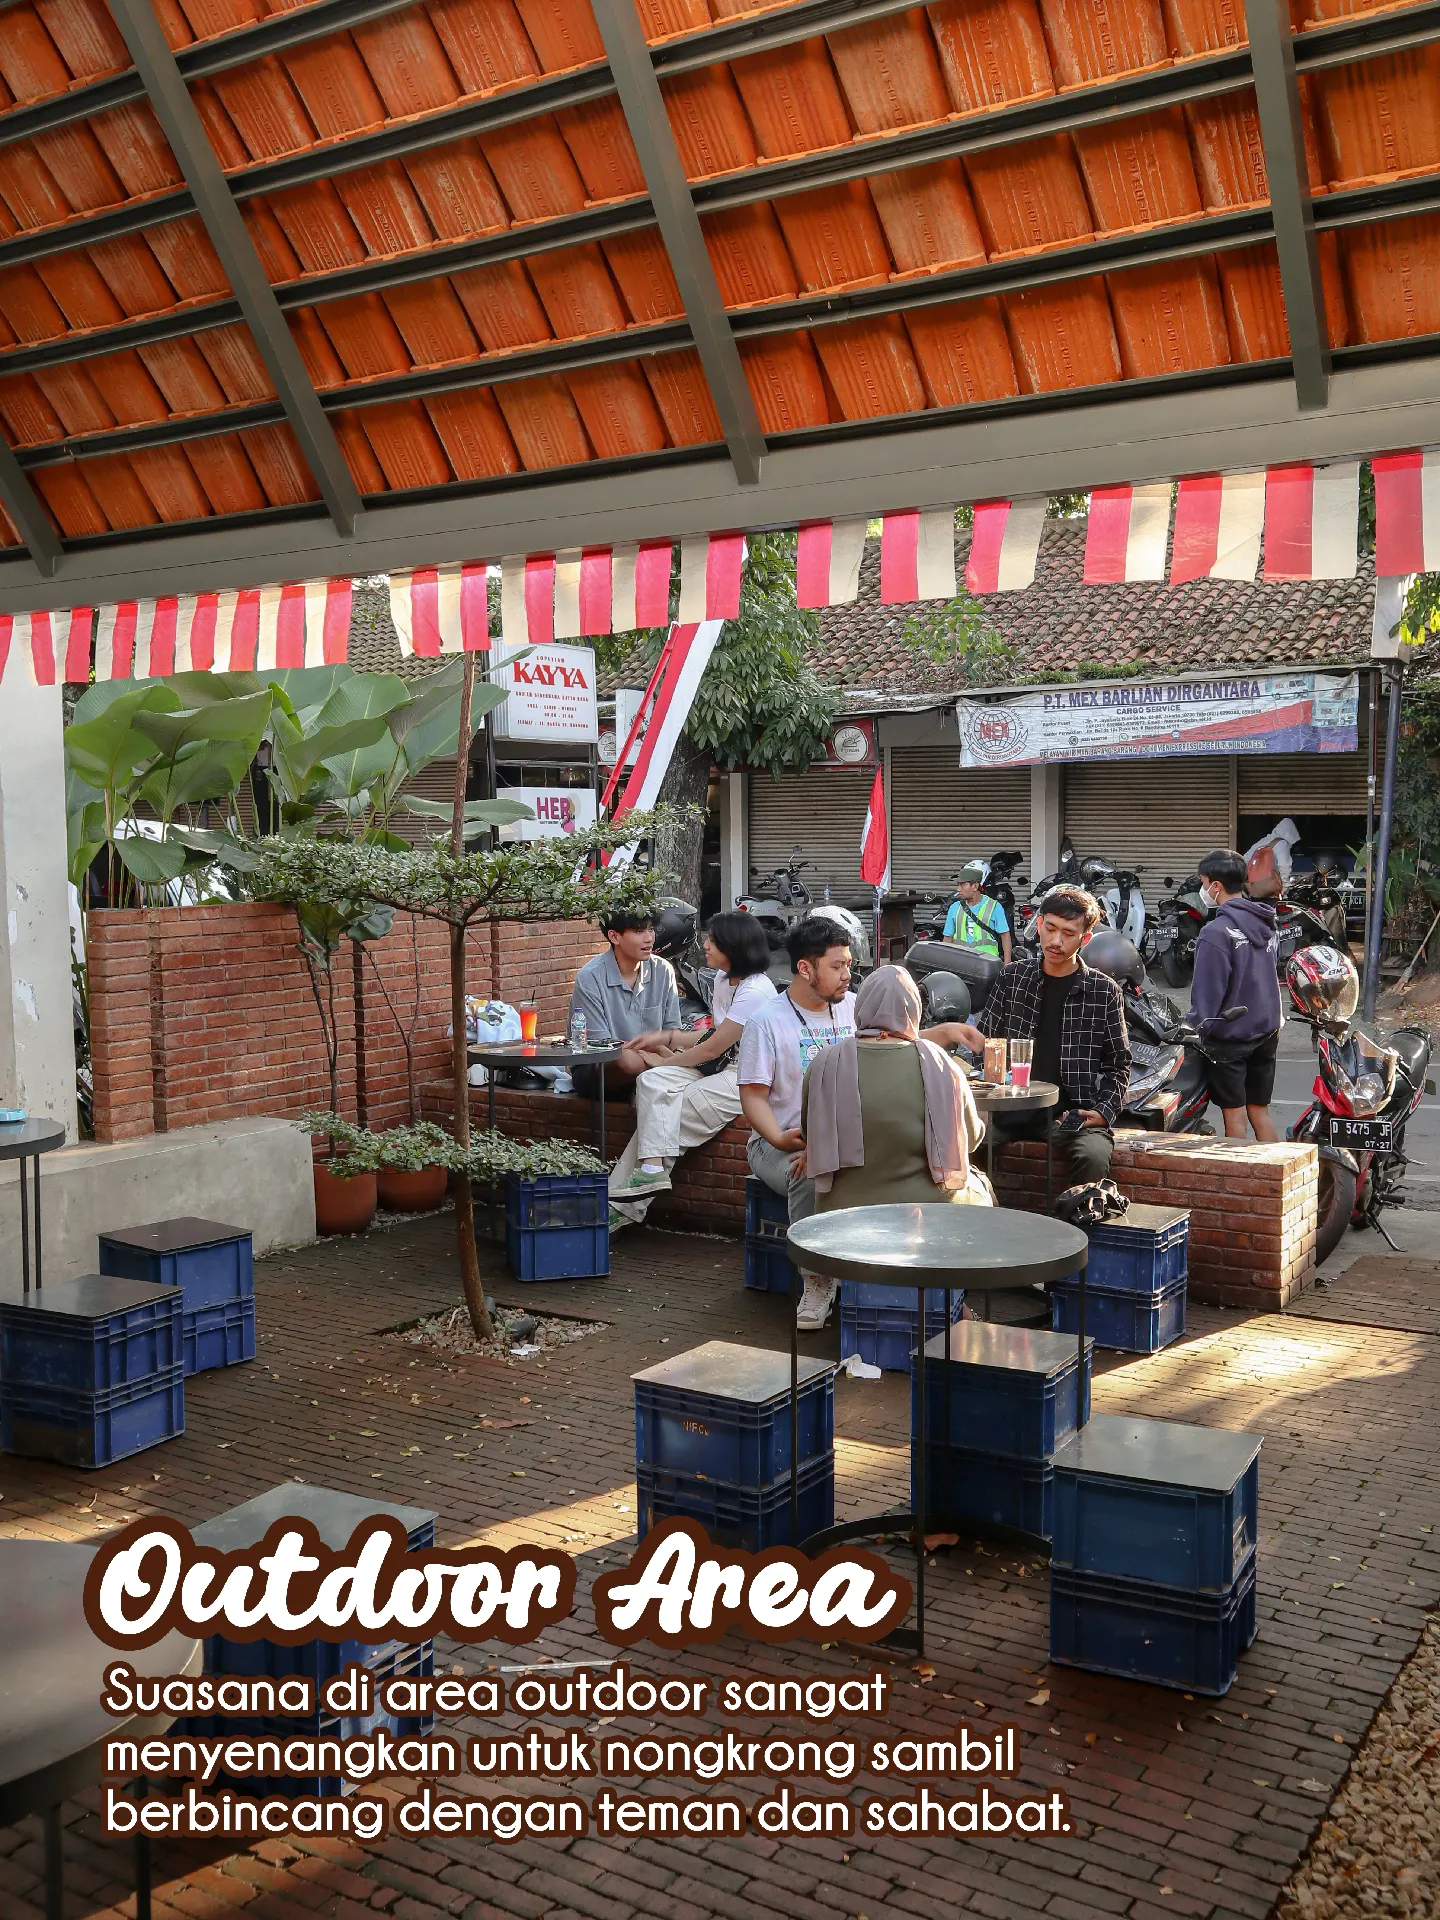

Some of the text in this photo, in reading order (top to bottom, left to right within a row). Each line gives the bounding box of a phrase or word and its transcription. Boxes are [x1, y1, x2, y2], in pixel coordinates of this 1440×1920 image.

[513, 661, 588, 689] KAYYA
[1068, 690, 1098, 707] MEX
[1102, 686, 1163, 706] BARLIAN
[1167, 680, 1261, 701] DIRGANTARA
[1116, 704, 1181, 715] CARGO SERVICE
[980, 721, 1009, 741] MEX
[1332, 1121, 1391, 1137] D 5475 JF
